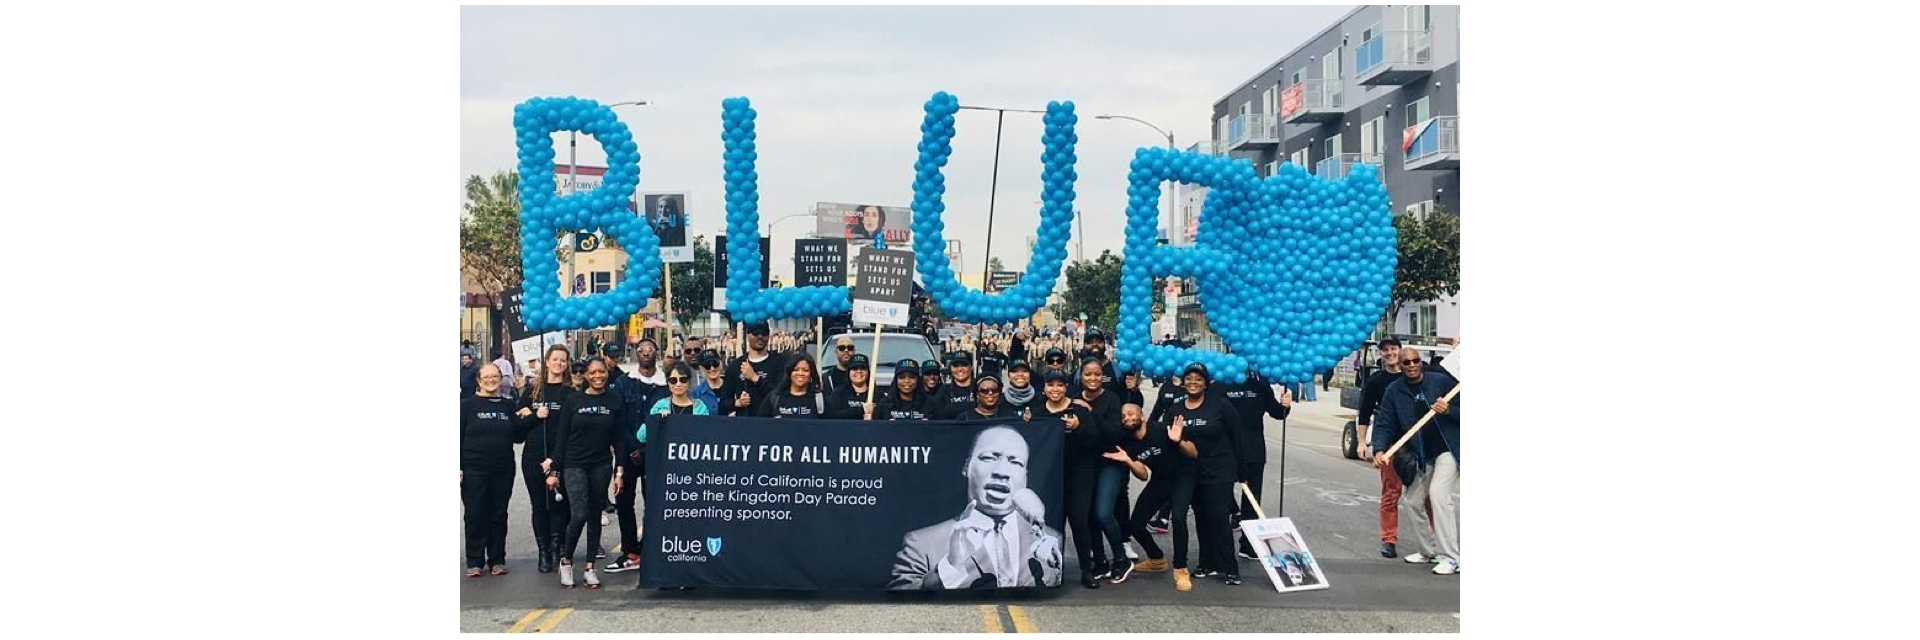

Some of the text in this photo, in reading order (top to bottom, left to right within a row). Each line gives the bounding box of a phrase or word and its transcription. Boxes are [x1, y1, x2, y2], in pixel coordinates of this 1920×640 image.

[804, 244, 838, 253] WHAT WE
[868, 254, 905, 265] WHAT WE
[805, 265, 837, 273] SETS US
[863, 264, 907, 276] STAND FOR
[809, 275, 833, 283] APART
[867, 275, 901, 287] SETS US
[869, 286, 896, 297] APART
[863, 303, 887, 314] blue
[667, 442, 932, 464] EQUALITY FOR ALL HUMANITY
[666, 472, 884, 491] Blue Shield of California is proud
[664, 489, 877, 507] to be the Kingdom Day Parade
[663, 505, 793, 521] presenting sponsor.
[661, 535, 702, 553] blue
[667, 553, 707, 563] california
